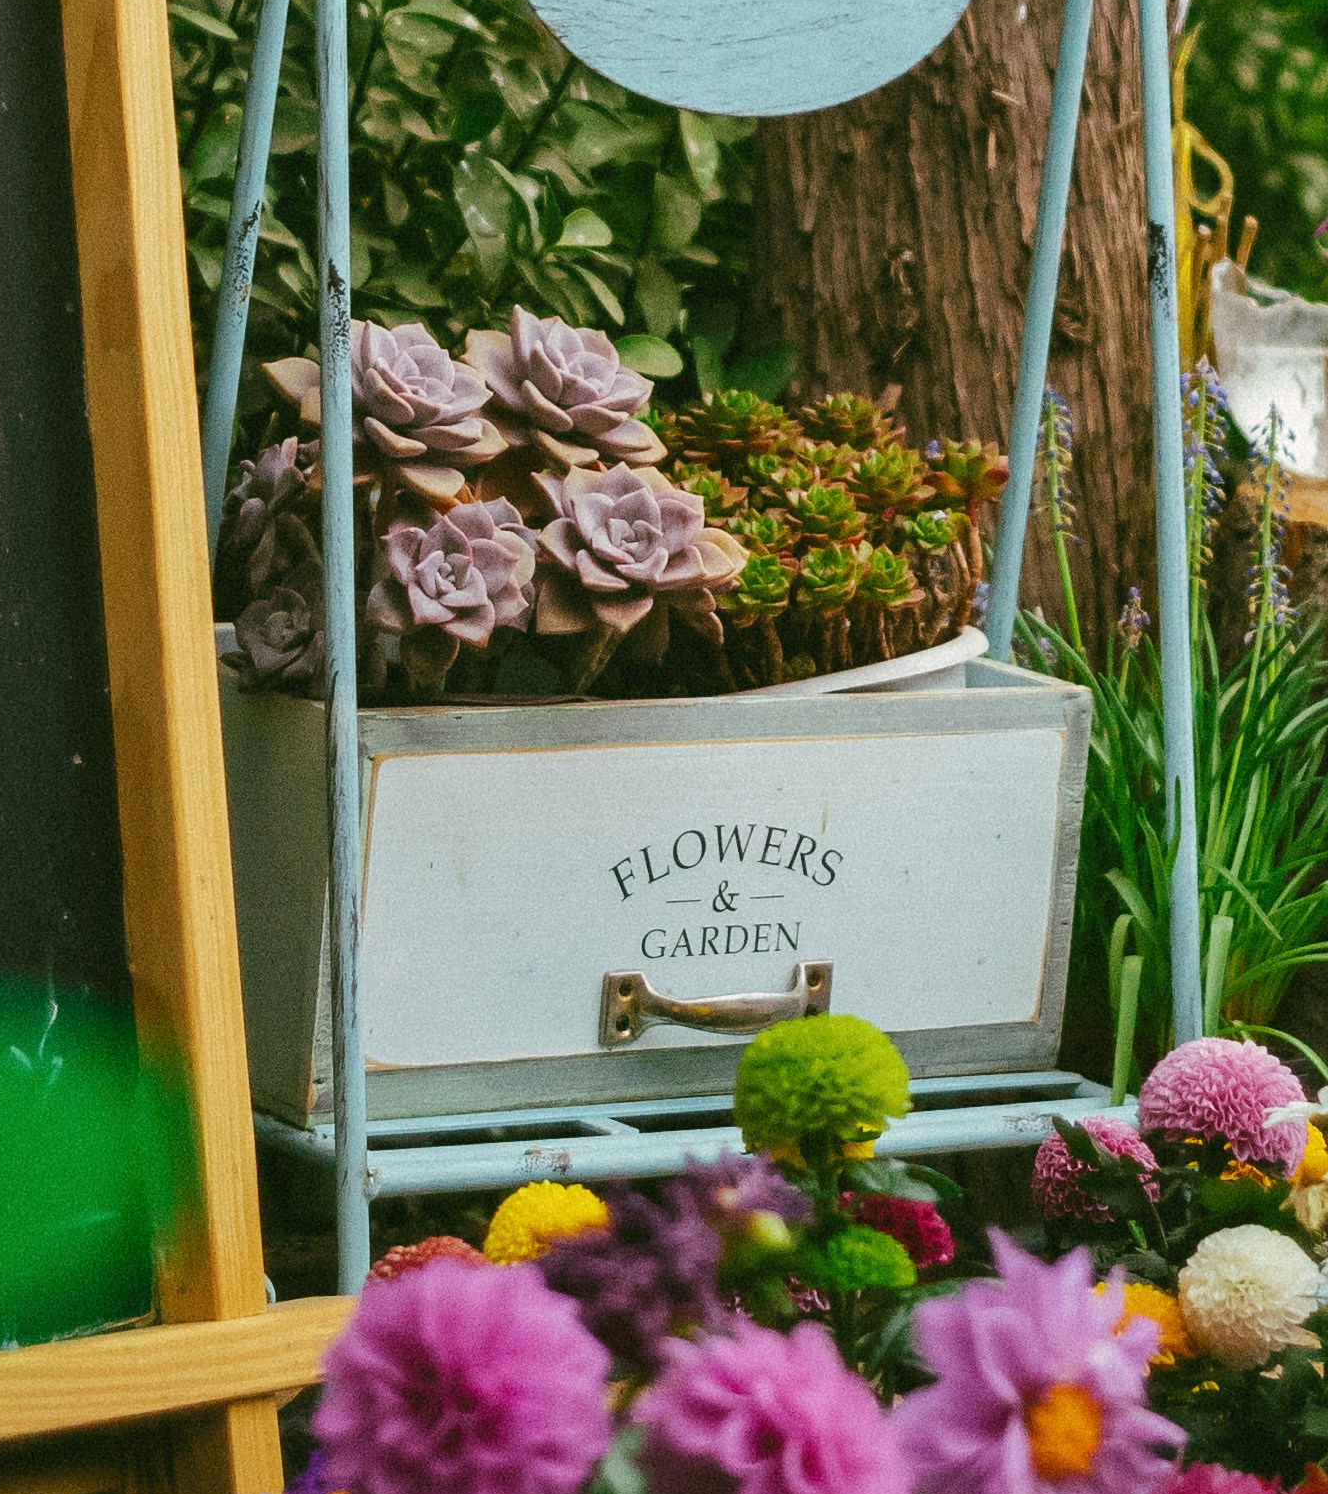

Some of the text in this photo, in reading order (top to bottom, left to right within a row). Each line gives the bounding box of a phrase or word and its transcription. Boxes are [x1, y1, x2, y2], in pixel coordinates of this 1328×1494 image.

[609, 823, 844, 901] FLOWERS
[711, 879, 741, 913] &
[640, 920, 802, 959] GARDEN
